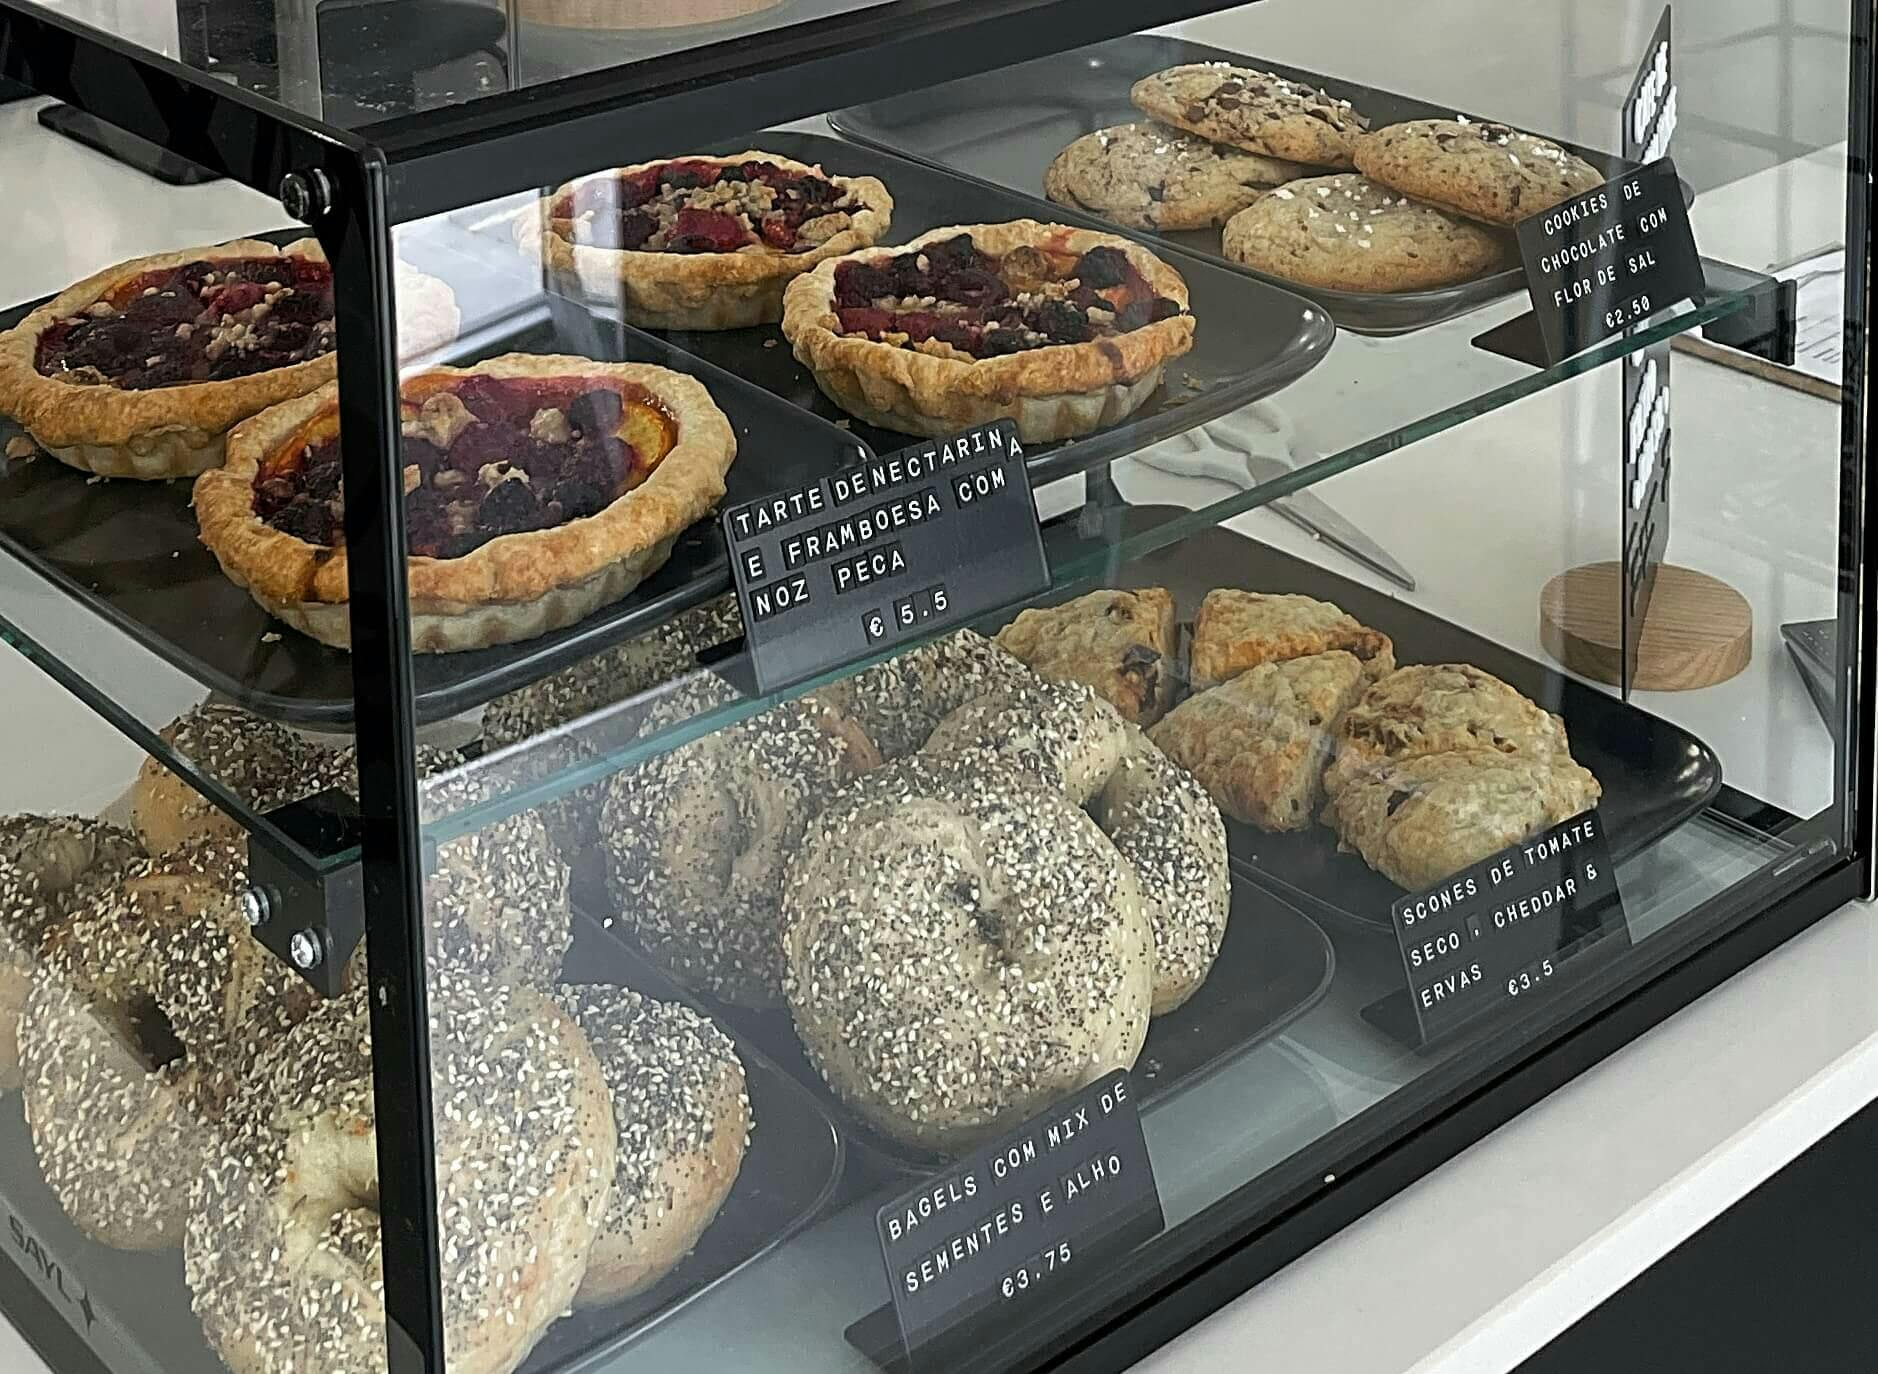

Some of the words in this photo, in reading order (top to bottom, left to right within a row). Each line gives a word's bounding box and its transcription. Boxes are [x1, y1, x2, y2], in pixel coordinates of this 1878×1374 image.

[1544, 193, 1608, 236] COOKIES
[1623, 181, 1641, 201] DE
[1541, 224, 1625, 273] CHOCOLATE
[1554, 279, 1591, 308] FLOR
[1597, 266, 1616, 286] DE
[1629, 251, 1656, 274] SAL
[1605, 296, 1650, 328] €2.50
[736, 488, 823, 536] TARTE
[748, 556, 763, 578] E
[788, 495, 941, 565] FRAMBOESA
[958, 467, 1006, 502] COM
[756, 578, 809, 617] NOZ
[837, 550, 905, 589] PECA
[1403, 878, 1477, 925] SCONES
[1491, 860, 1514, 885] DE
[1524, 821, 1595, 865] TOMATE
[1411, 932, 1460, 967] SECO
[1494, 878, 1577, 929] CHEDDAR
[1585, 863, 1597, 880] &
[1421, 964, 1482, 1008] ERVAS
[1508, 960, 1553, 996] €3.5
[888, 1176, 978, 1240] BAGELS
[994, 1140, 1036, 1178] COM
[1047, 1108, 1089, 1147] MIX
[1100, 1082, 1127, 1114] DE
[906, 1202, 1024, 1293] SEMENTES
[1040, 1192, 1054, 1212] E
[1066, 1155, 1121, 1199] ALHO
[1001, 1242, 1072, 1298] €3.75
